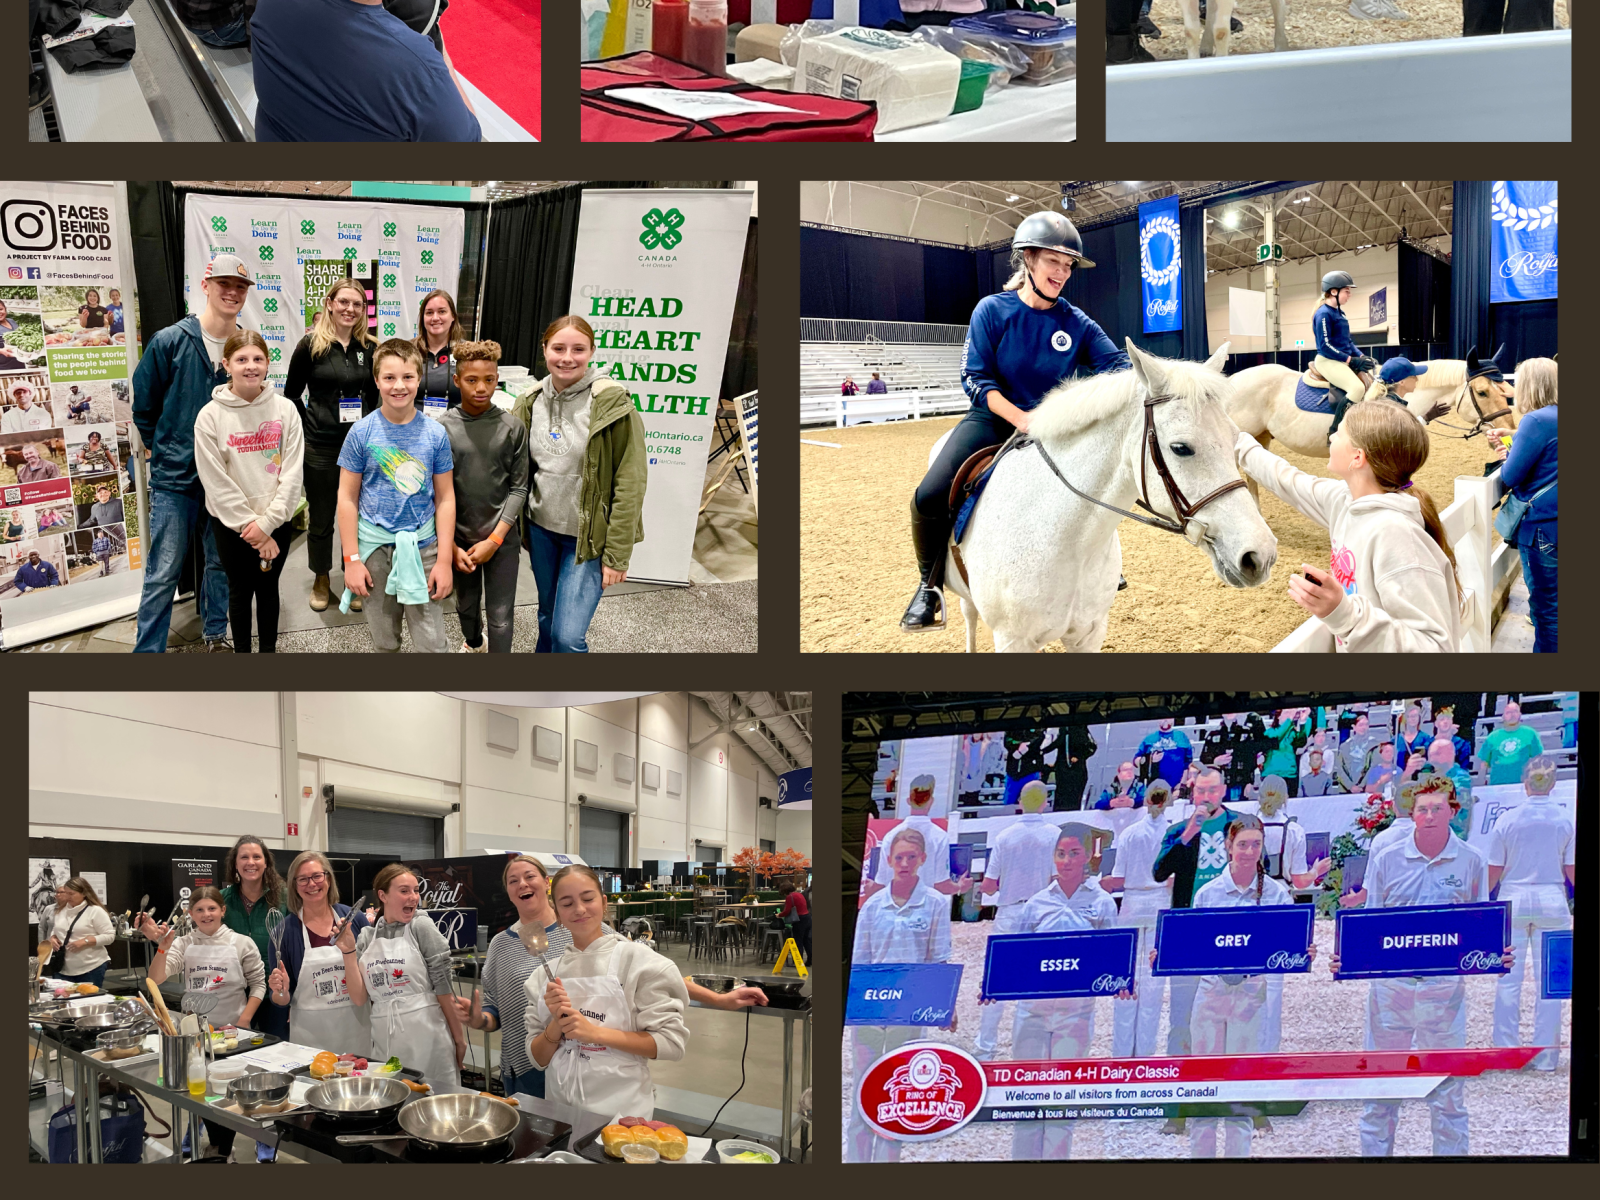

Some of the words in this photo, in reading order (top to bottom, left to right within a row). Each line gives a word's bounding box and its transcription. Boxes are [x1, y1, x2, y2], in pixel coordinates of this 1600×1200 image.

[58, 204, 109, 221] FACES
[60, 220, 110, 234] BEHIND
[61, 233, 112, 250] FOOD
[251, 230, 278, 240] Doing
[337, 232, 362, 241] Doing
[417, 236, 440, 245] Doing
[209, 244, 235, 252] Learn
[1260, 244, 1271, 260] D
[1274, 244, 1283, 259] D
[306, 264, 344, 276] SHARE
[378, 260, 401, 268] Doing
[46, 272, 114, 280] @FacesBehindFood
[256, 283, 281, 292] Doing
[306, 285, 326, 297] 4-H
[580, 284, 634, 299] Clear
[379, 309, 400, 317] Doing
[588, 296, 683, 318] HEAD
[1147, 299, 1179, 317] Royal
[589, 319, 630, 333] oyal
[261, 334, 285, 342] Doing
[593, 329, 701, 352] HEART
[52, 352, 85, 361] Sharing
[590, 351, 650, 367] erving
[53, 361, 68, 369] the
[70, 360, 97, 369] people
[54, 369, 74, 377] food
[630, 393, 711, 416] ALTH
[645, 430, 703, 442] HOntario.ca
[646, 445, 682, 455] 0.6748
[435, 880, 451, 891] The
[1215, 934, 1251, 947] GREY
[1383, 932, 1458, 949] DUFFERIN
[1040, 958, 1080, 971] ESSEX
[1267, 950, 1309, 969] Royal
[1460, 950, 1503, 970] Roya
[1091, 973, 1131, 993] Royal
[864, 989, 902, 1000] ELGIN
[911, 1006, 950, 1022] Royal
[993, 1069, 1011, 1082] TD
[1014, 1067, 1071, 1082] Canadian
[1074, 1067, 1097, 1080] 4-H
[1101, 1065, 1133, 1082] Dairy
[1135, 1065, 1179, 1079] Classic
[906, 1091, 925, 1100] RING
[926, 1090, 938, 1099] OF
[1005, 1090, 1050, 1101] Welcome
[1053, 1089, 1062, 1100] to
[1065, 1089, 1076, 1100] all
[1079, 1088, 1112, 1099] visitors
[1115, 1087, 1137, 1099] from
[1140, 1088, 1173, 1098] across
[1175, 1086, 1218, 1098] Canada!
[879, 1101, 962, 1120] EXCELLENCE
[992, 1109, 1036, 1119] Bienvenue
[1037, 1108, 1043, 1118] à
[1045, 1108, 1063, 1118] tous
[1065, 1108, 1078, 1118] les
[1080, 1107, 1115, 1118] visiteurs
[1117, 1106, 1128, 1117] du
[1130, 1106, 1164, 1117] Canada
